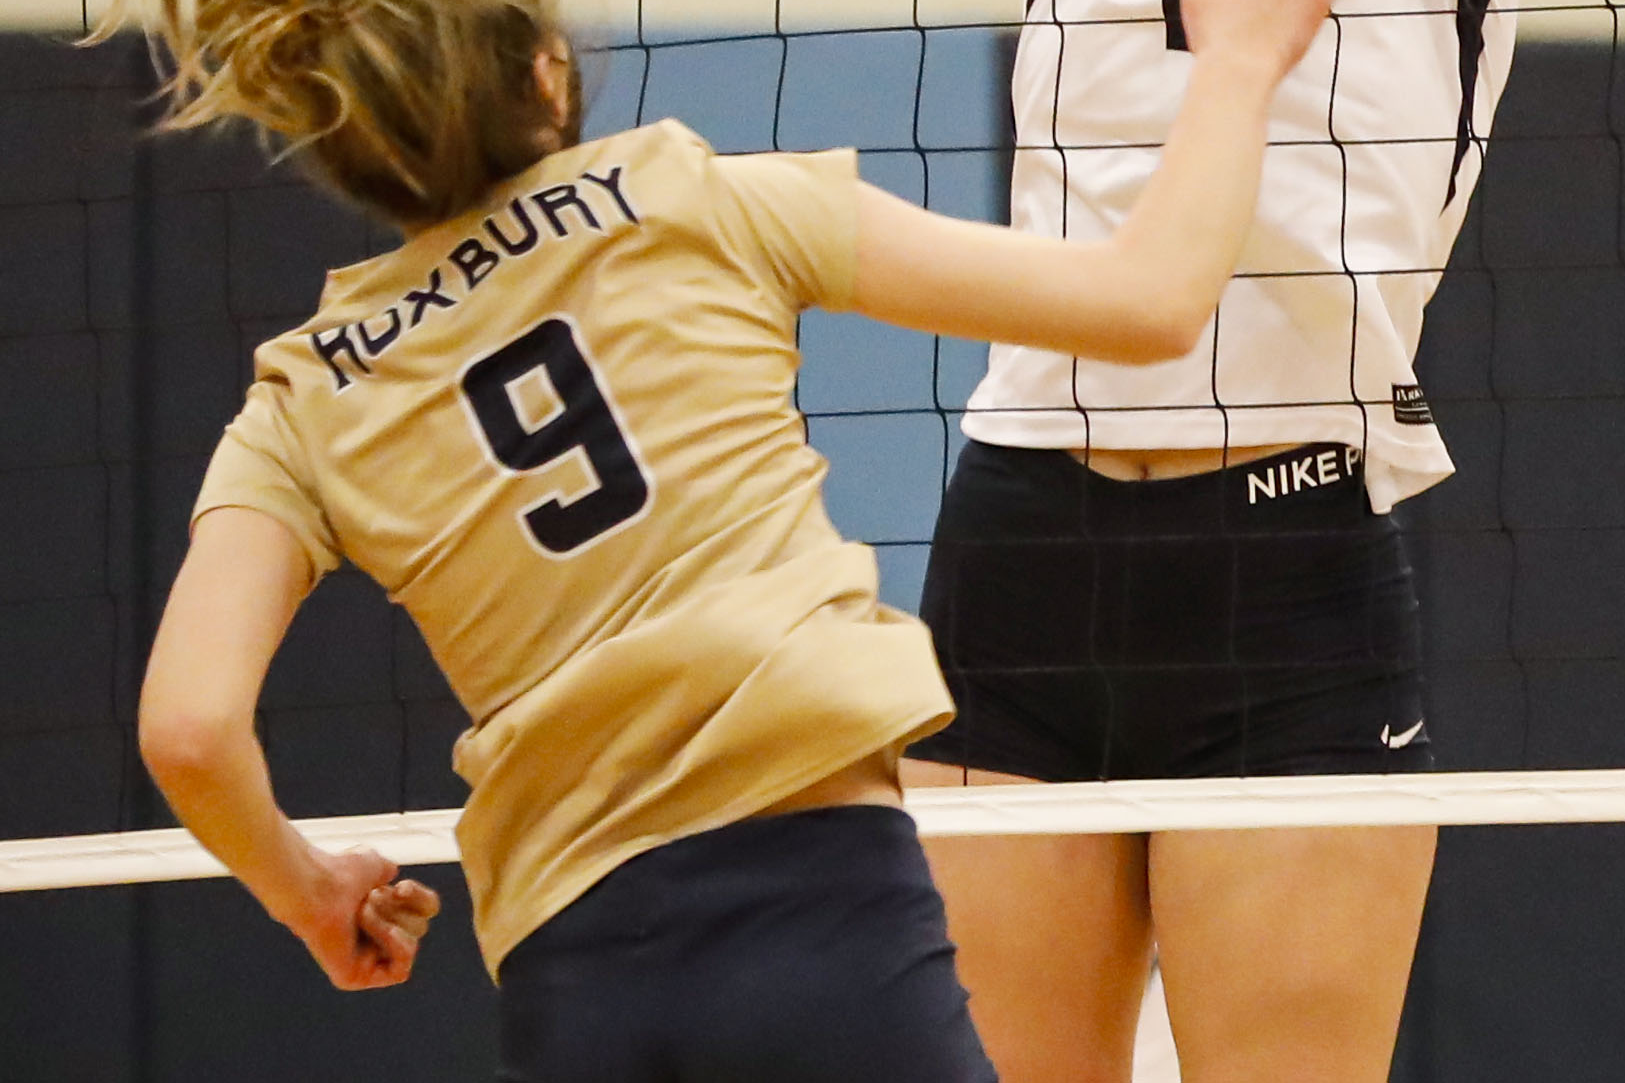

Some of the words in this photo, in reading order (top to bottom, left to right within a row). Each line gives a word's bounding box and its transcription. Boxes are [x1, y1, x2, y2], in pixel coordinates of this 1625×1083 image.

[311, 165, 641, 393] ROXBURY
[458, 315, 652, 557] 9
[1247, 449, 1340, 505] NIKE
